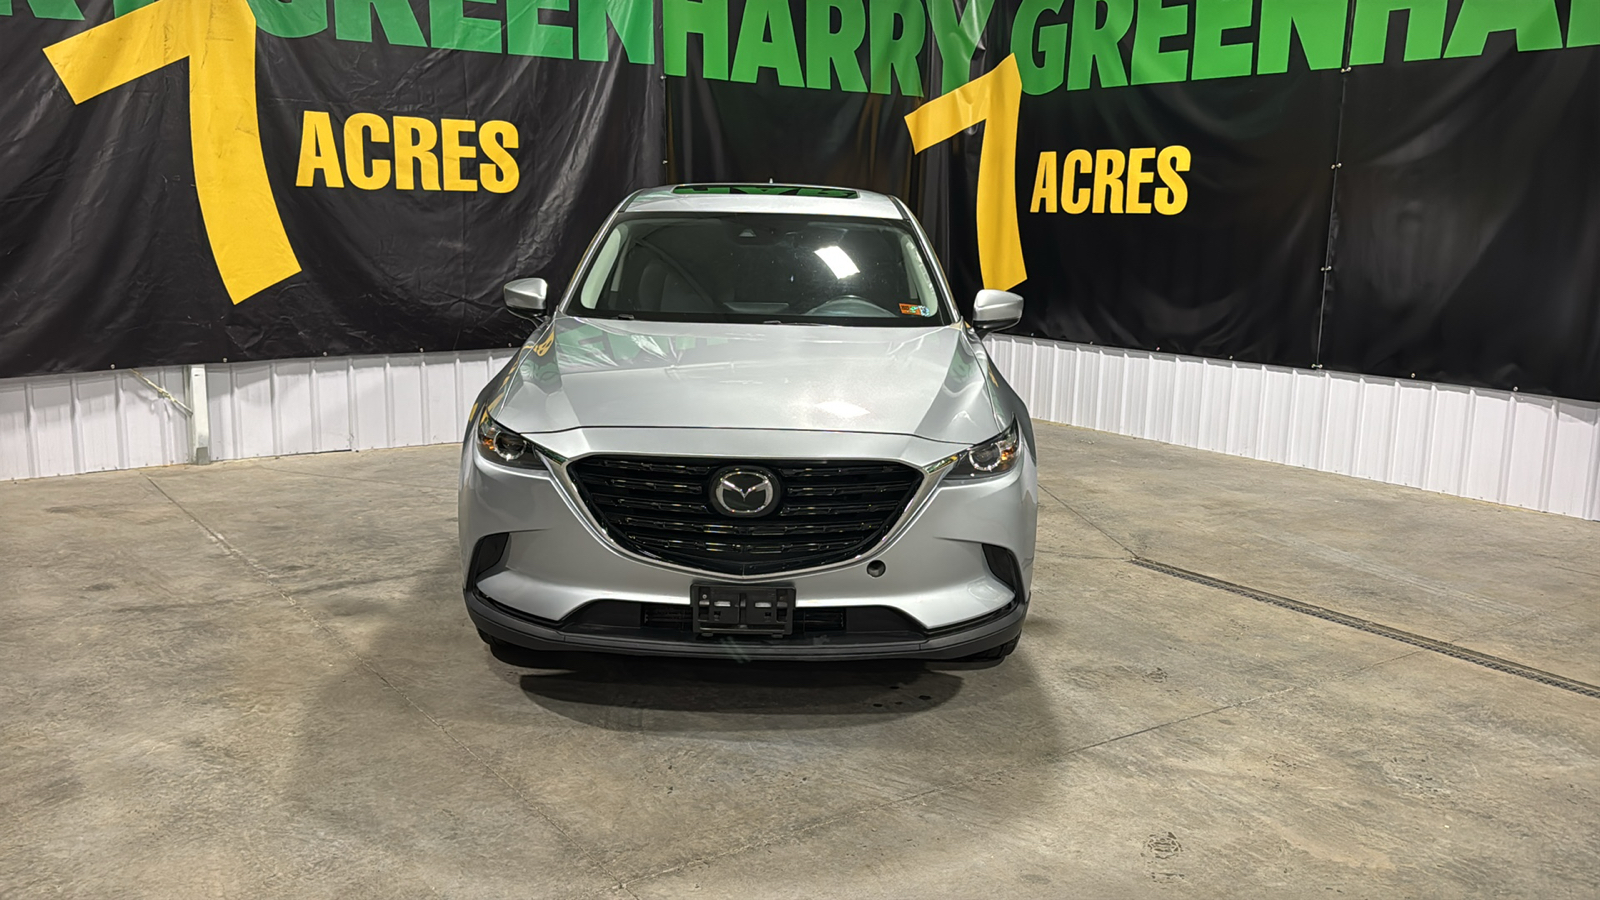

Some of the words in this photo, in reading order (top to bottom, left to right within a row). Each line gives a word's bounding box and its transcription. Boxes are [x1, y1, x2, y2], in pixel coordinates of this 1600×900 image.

[662, 0, 995, 97] HARRY
[1009, 0, 1349, 96] GREEN
[295, 110, 520, 193] ACRES
[905, 53, 1028, 292] 7
[1030, 145, 1192, 216] ACRES
